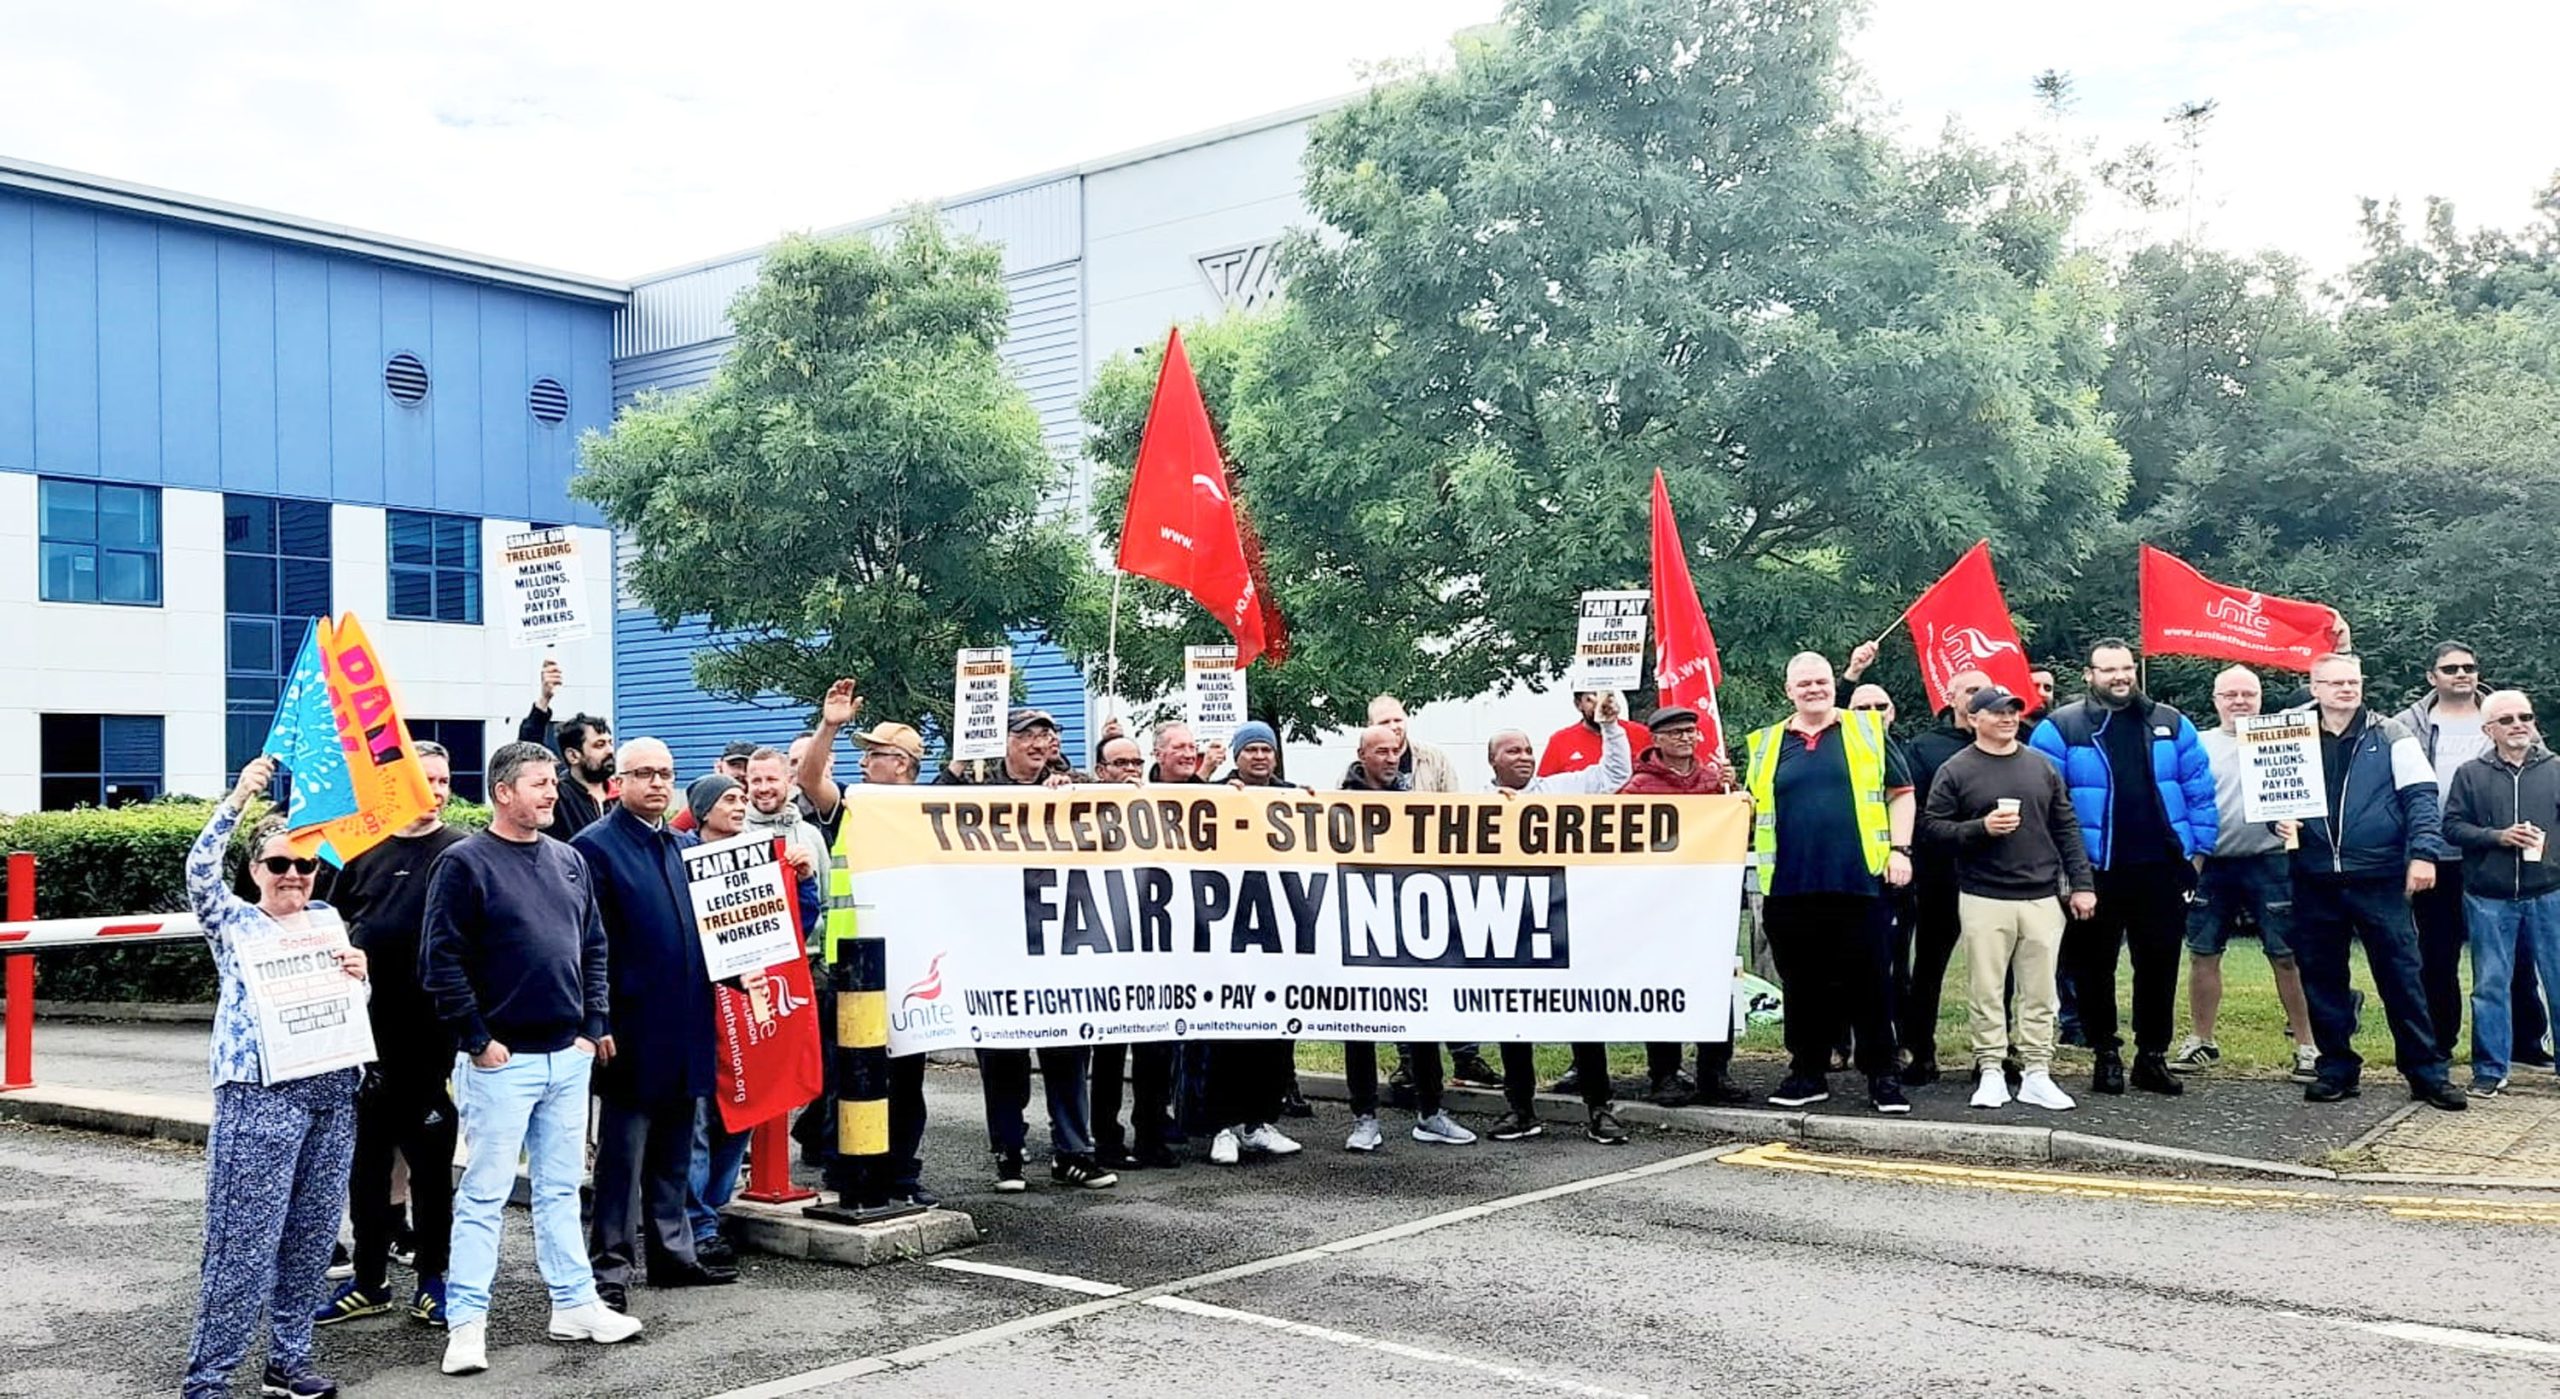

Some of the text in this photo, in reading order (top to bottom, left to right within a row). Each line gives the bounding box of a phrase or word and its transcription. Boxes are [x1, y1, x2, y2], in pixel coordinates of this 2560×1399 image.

[506, 544, 572, 562] TRELLEBORG
[519, 561, 562, 575] MAKING
[515, 573, 570, 588] MILLIONS,
[527, 587, 561, 600] LOUSY
[525, 598, 567, 613] PAY FOR
[1584, 600, 1646, 617] FAIR PAY
[521, 611, 574, 627] WORKERS
[1605, 618, 1623, 628] FOR
[1587, 631, 1638, 641] LEICESTER
[1581, 643, 1641, 654] TRELLEBORG
[1192, 660, 1236, 669] TRELLEBOR
[1587, 656, 1633, 667] WORKERS
[2246, 727, 2311, 743] TRELLEBORG
[2257, 743, 2300, 755] MAKING
[2265, 766, 2298, 778] LOUSY
[2262, 777, 2304, 789] PAY FOR
[2258, 789, 2311, 803] WORKERS
[922, 800, 1217, 851] TRELLEBORG
[1267, 801, 1391, 853] STOP
[1405, 804, 1503, 854] THE
[1519, 803, 1679, 855] GREED
[690, 842, 771, 881] FAIR PAY
[724, 871, 750, 890] FOR
[706, 883, 775, 912] LEICESTER
[703, 898, 785, 931] TRELLEBORG
[1023, 867, 1552, 960] FAIR PAY NOW!
[716, 917, 780, 946] WORKERS
[255, 954, 314, 981] TORIES
[964, 989, 1019, 1016] UNITE
[1024, 985, 1121, 1016] FIGHTING
[1125, 984, 1156, 1012] FOR
[1157, 984, 1197, 1010] JOBS
[1220, 984, 1256, 1010] PAY
[1284, 984, 1429, 1012] CONDITIONS!
[1453, 987, 1686, 1014] UNITETHEUNION.ORG
[716, 982, 746, 1103] nitetheunion.org
